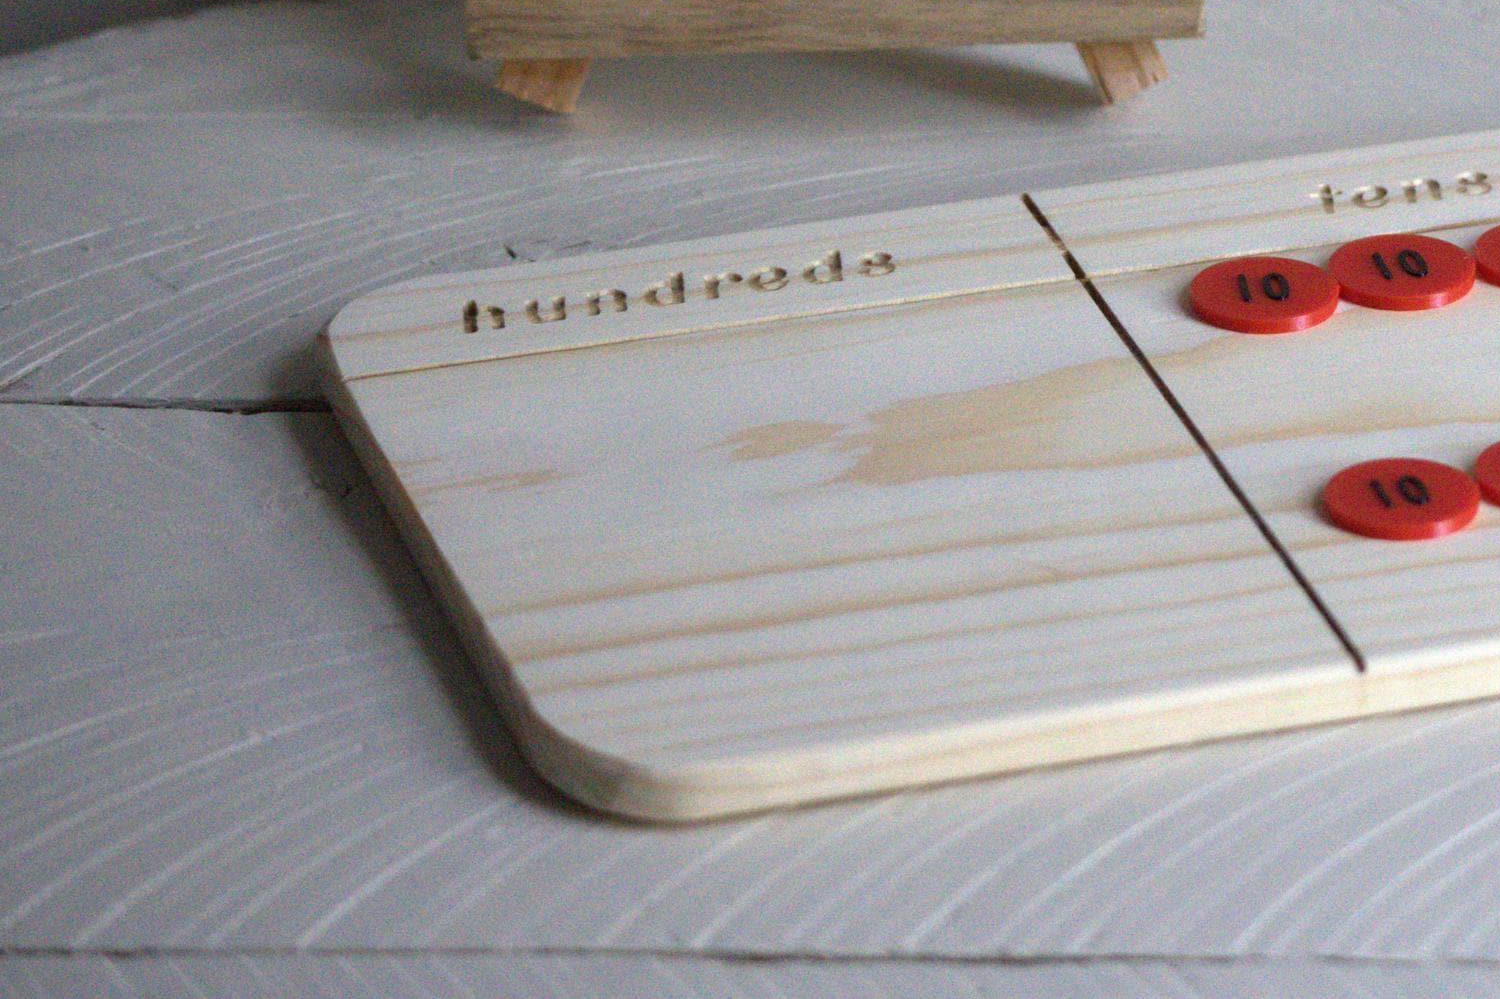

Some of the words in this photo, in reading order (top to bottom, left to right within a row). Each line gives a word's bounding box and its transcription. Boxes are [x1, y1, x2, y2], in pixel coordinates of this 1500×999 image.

[1309, 171, 1492, 214] tens
[1371, 247, 1430, 281] 10
[462, 248, 896, 334] hundreds
[1237, 270, 1291, 303] 10
[1369, 473, 1431, 510] 10
